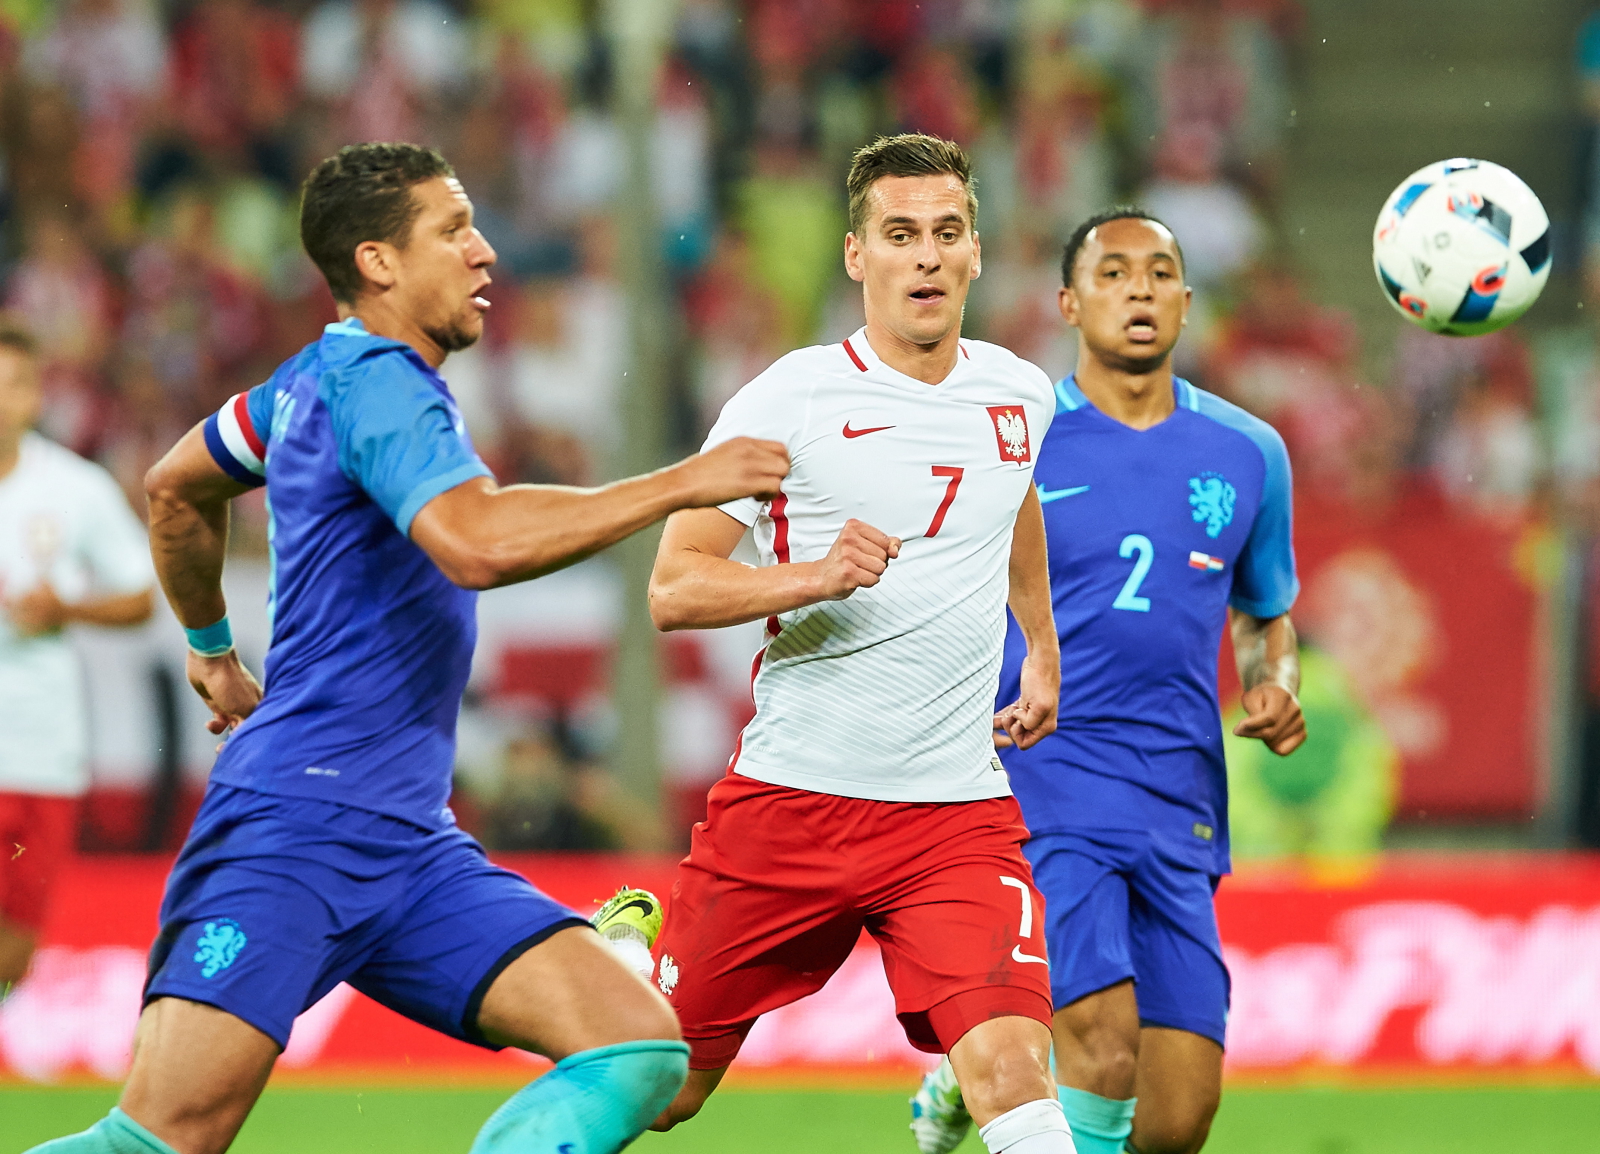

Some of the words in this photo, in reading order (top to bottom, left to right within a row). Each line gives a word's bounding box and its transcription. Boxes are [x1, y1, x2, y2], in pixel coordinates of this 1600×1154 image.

[924, 466, 964, 537] 7
[1112, 534, 1154, 612] 2
[999, 876, 1032, 938] 7
